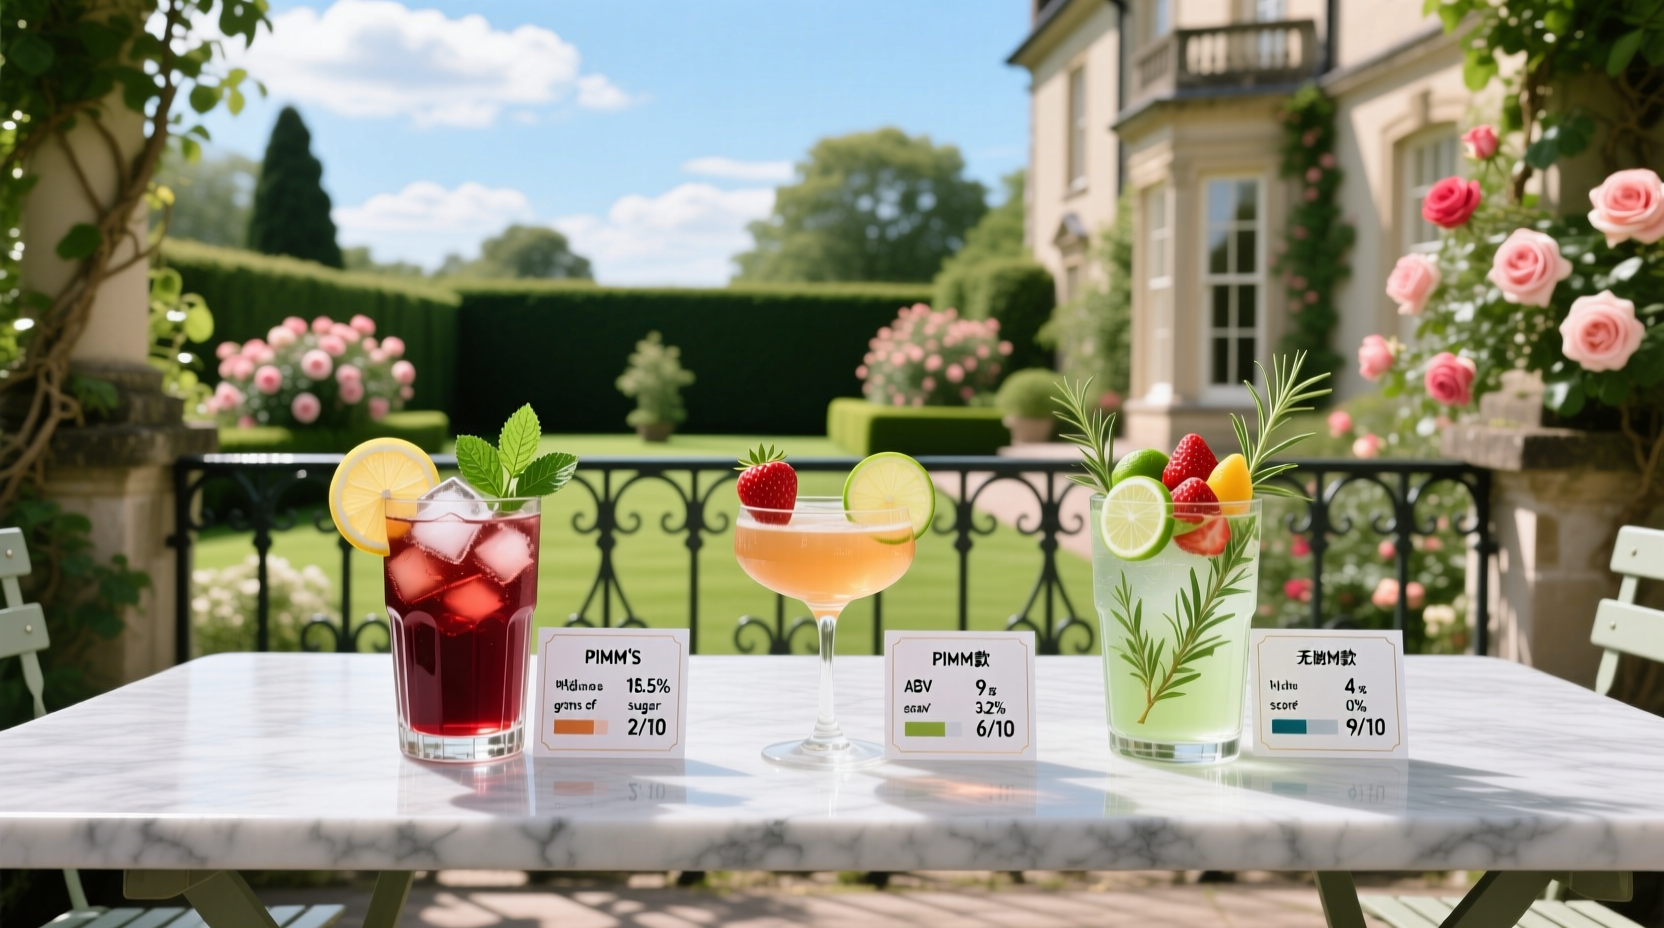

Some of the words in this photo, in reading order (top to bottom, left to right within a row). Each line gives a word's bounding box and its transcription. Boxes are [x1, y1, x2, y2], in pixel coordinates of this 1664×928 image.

[585, 647, 642, 665] PIMM'S
[627, 717, 667, 737] 2/10
[976, 719, 1015, 738] 6/10
[1345, 717, 1386, 737] 9/10
